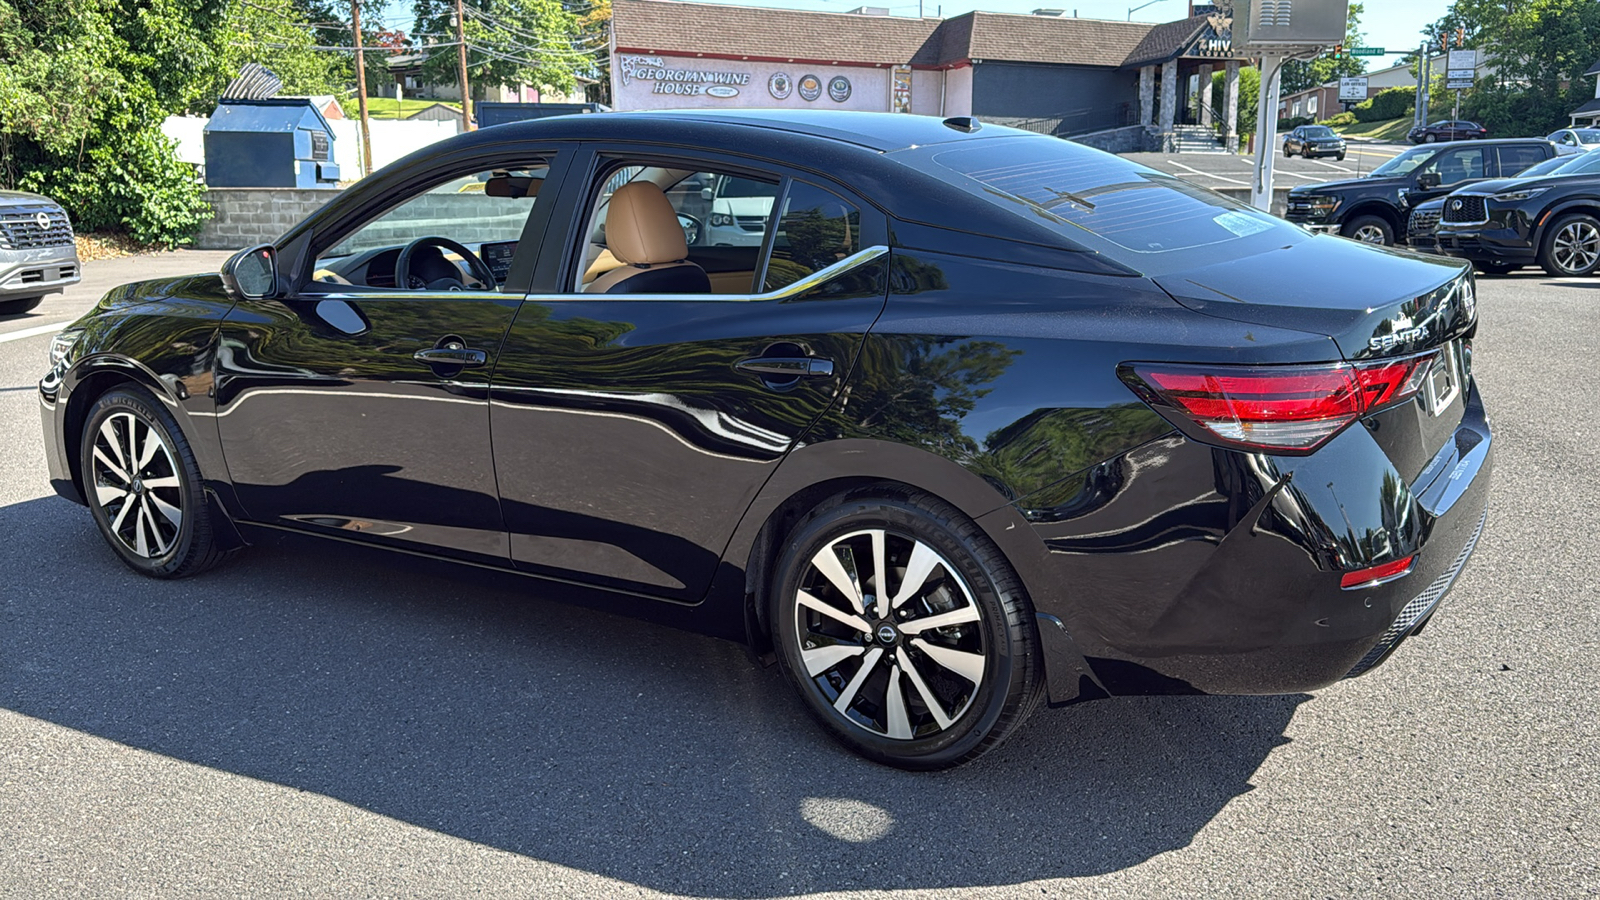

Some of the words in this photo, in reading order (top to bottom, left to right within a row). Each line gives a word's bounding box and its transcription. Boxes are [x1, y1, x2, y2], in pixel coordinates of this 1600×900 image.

[1208, 39, 1235, 52] HIV
[636, 68, 709, 83] GEORGIAN
[713, 72, 750, 85] WINE
[652, 82, 700, 96] HOUSE
[1369, 326, 1430, 350] SENTRA
[112, 396, 154, 420] MICHELIN
[910, 515, 990, 588] MICHELIN
[989, 601, 1004, 638] PRIMACY
